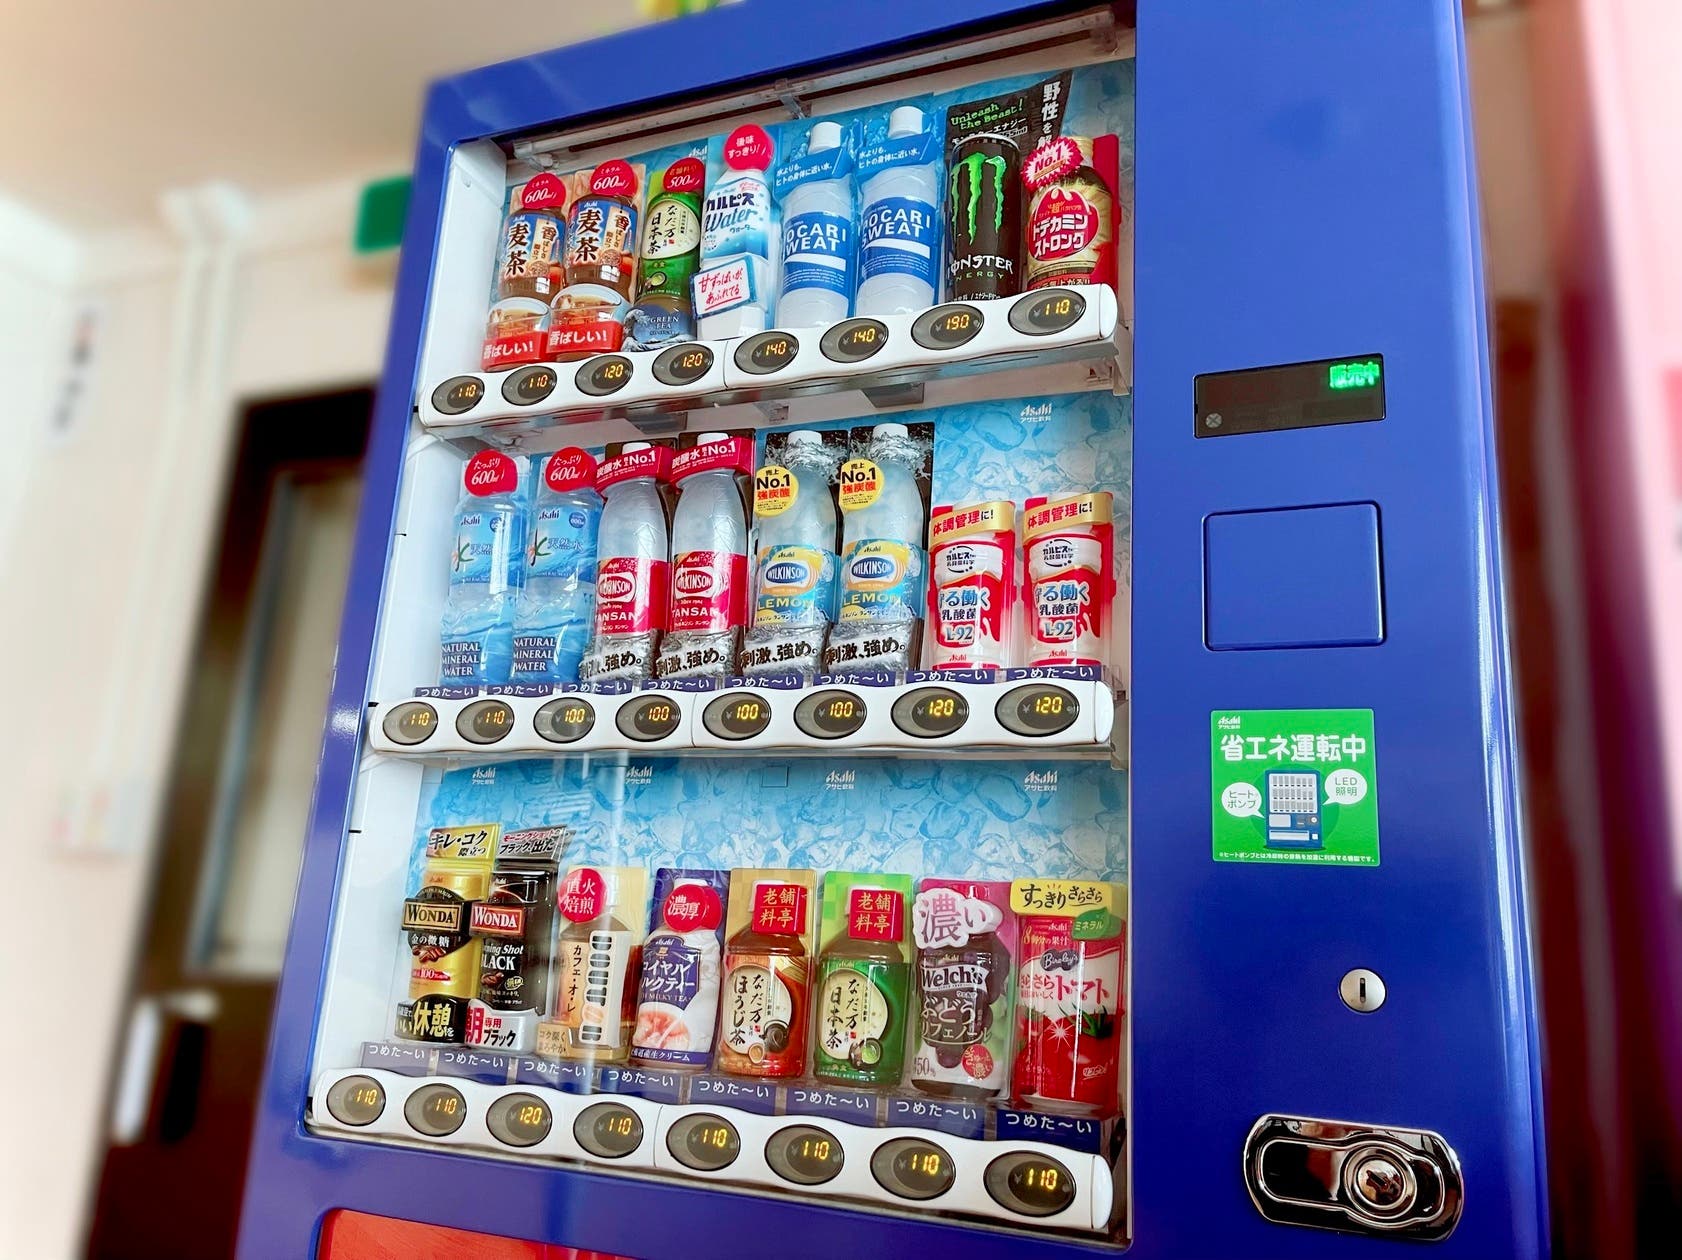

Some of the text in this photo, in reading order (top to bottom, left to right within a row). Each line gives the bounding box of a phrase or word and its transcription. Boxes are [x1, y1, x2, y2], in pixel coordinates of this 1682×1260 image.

[951, 103, 999, 126] Unleash
[960, 120, 981, 130] the
[706, 192, 755, 212] カルピス
[705, 208, 758, 232] Water
[1033, 213, 1089, 242] ドデカミン
[575, 209, 602, 263] 麦茶
[648, 212, 663, 256] 日本茶
[784, 224, 846, 243] OCARI
[505, 223, 530, 277] 麦茶
[785, 237, 841, 256] WEAT
[1033, 232, 1085, 259] ストロング
[650, 316, 680, 324] GREEN
[1020, 403, 1052, 417] Asahi
[473, 458, 500, 470] たっぷり
[553, 454, 582, 466] たっぷり
[756, 474, 791, 490] No.1
[841, 467, 877, 484] No.1
[757, 487, 791, 501] 強炭酸
[842, 481, 877, 496] 強炭酸
[460, 514, 481, 526] Asahi
[538, 509, 560, 521] Asahi
[932, 509, 994, 537] 体調管理に!
[1027, 501, 1093, 531] 体調管理に!
[942, 608, 977, 621] 乳酸菌
[1039, 603, 1079, 616] 乳酸菌
[946, 626, 973, 641] L-92
[1044, 621, 1074, 637] L-92
[441, 643, 481, 652] NATURAL
[514, 637, 556, 647] NATURAL
[444, 667, 474, 676] WATER
[514, 661, 546, 671] WATER
[1218, 715, 1241, 724] Asahi
[1220, 734, 1366, 763] 省エネ運転中
[472, 767, 496, 779] Asahi
[626, 765, 652, 778] Asahi
[826, 769, 855, 783] Asahi
[1024, 770, 1058, 784] Asahi
[1335, 776, 1358, 786] LED
[1228, 790, 1254, 799] ヒート
[1336, 786, 1358, 797] 照明
[1227, 799, 1257, 809] ポンプ
[429, 830, 488, 850] キレ・コク
[566, 878, 596, 896] 直火
[762, 887, 797, 905] 老舗
[857, 892, 892, 911] 老舗
[407, 904, 455, 924] WONDA
[563, 896, 595, 915] 焙煎
[667, 895, 700, 921] 濃厚
[474, 906, 518, 928] WONDA
[759, 907, 794, 928] 料亭
[854, 913, 891, 934] 料亭
[919, 893, 987, 943] 濃い
[1074, 921, 1104, 932] ミネラル
[501, 944, 524, 955] Shot
[922, 965, 983, 988] Welch's
[749, 974, 765, 1024] なだ万
[844, 978, 860, 1030] なだ万
[729, 975, 748, 1047] ほうじ茶
[826, 986, 843, 1050] 日本茶
[485, 1017, 502, 1028] 専用
[484, 1029, 516, 1047] ブラック
